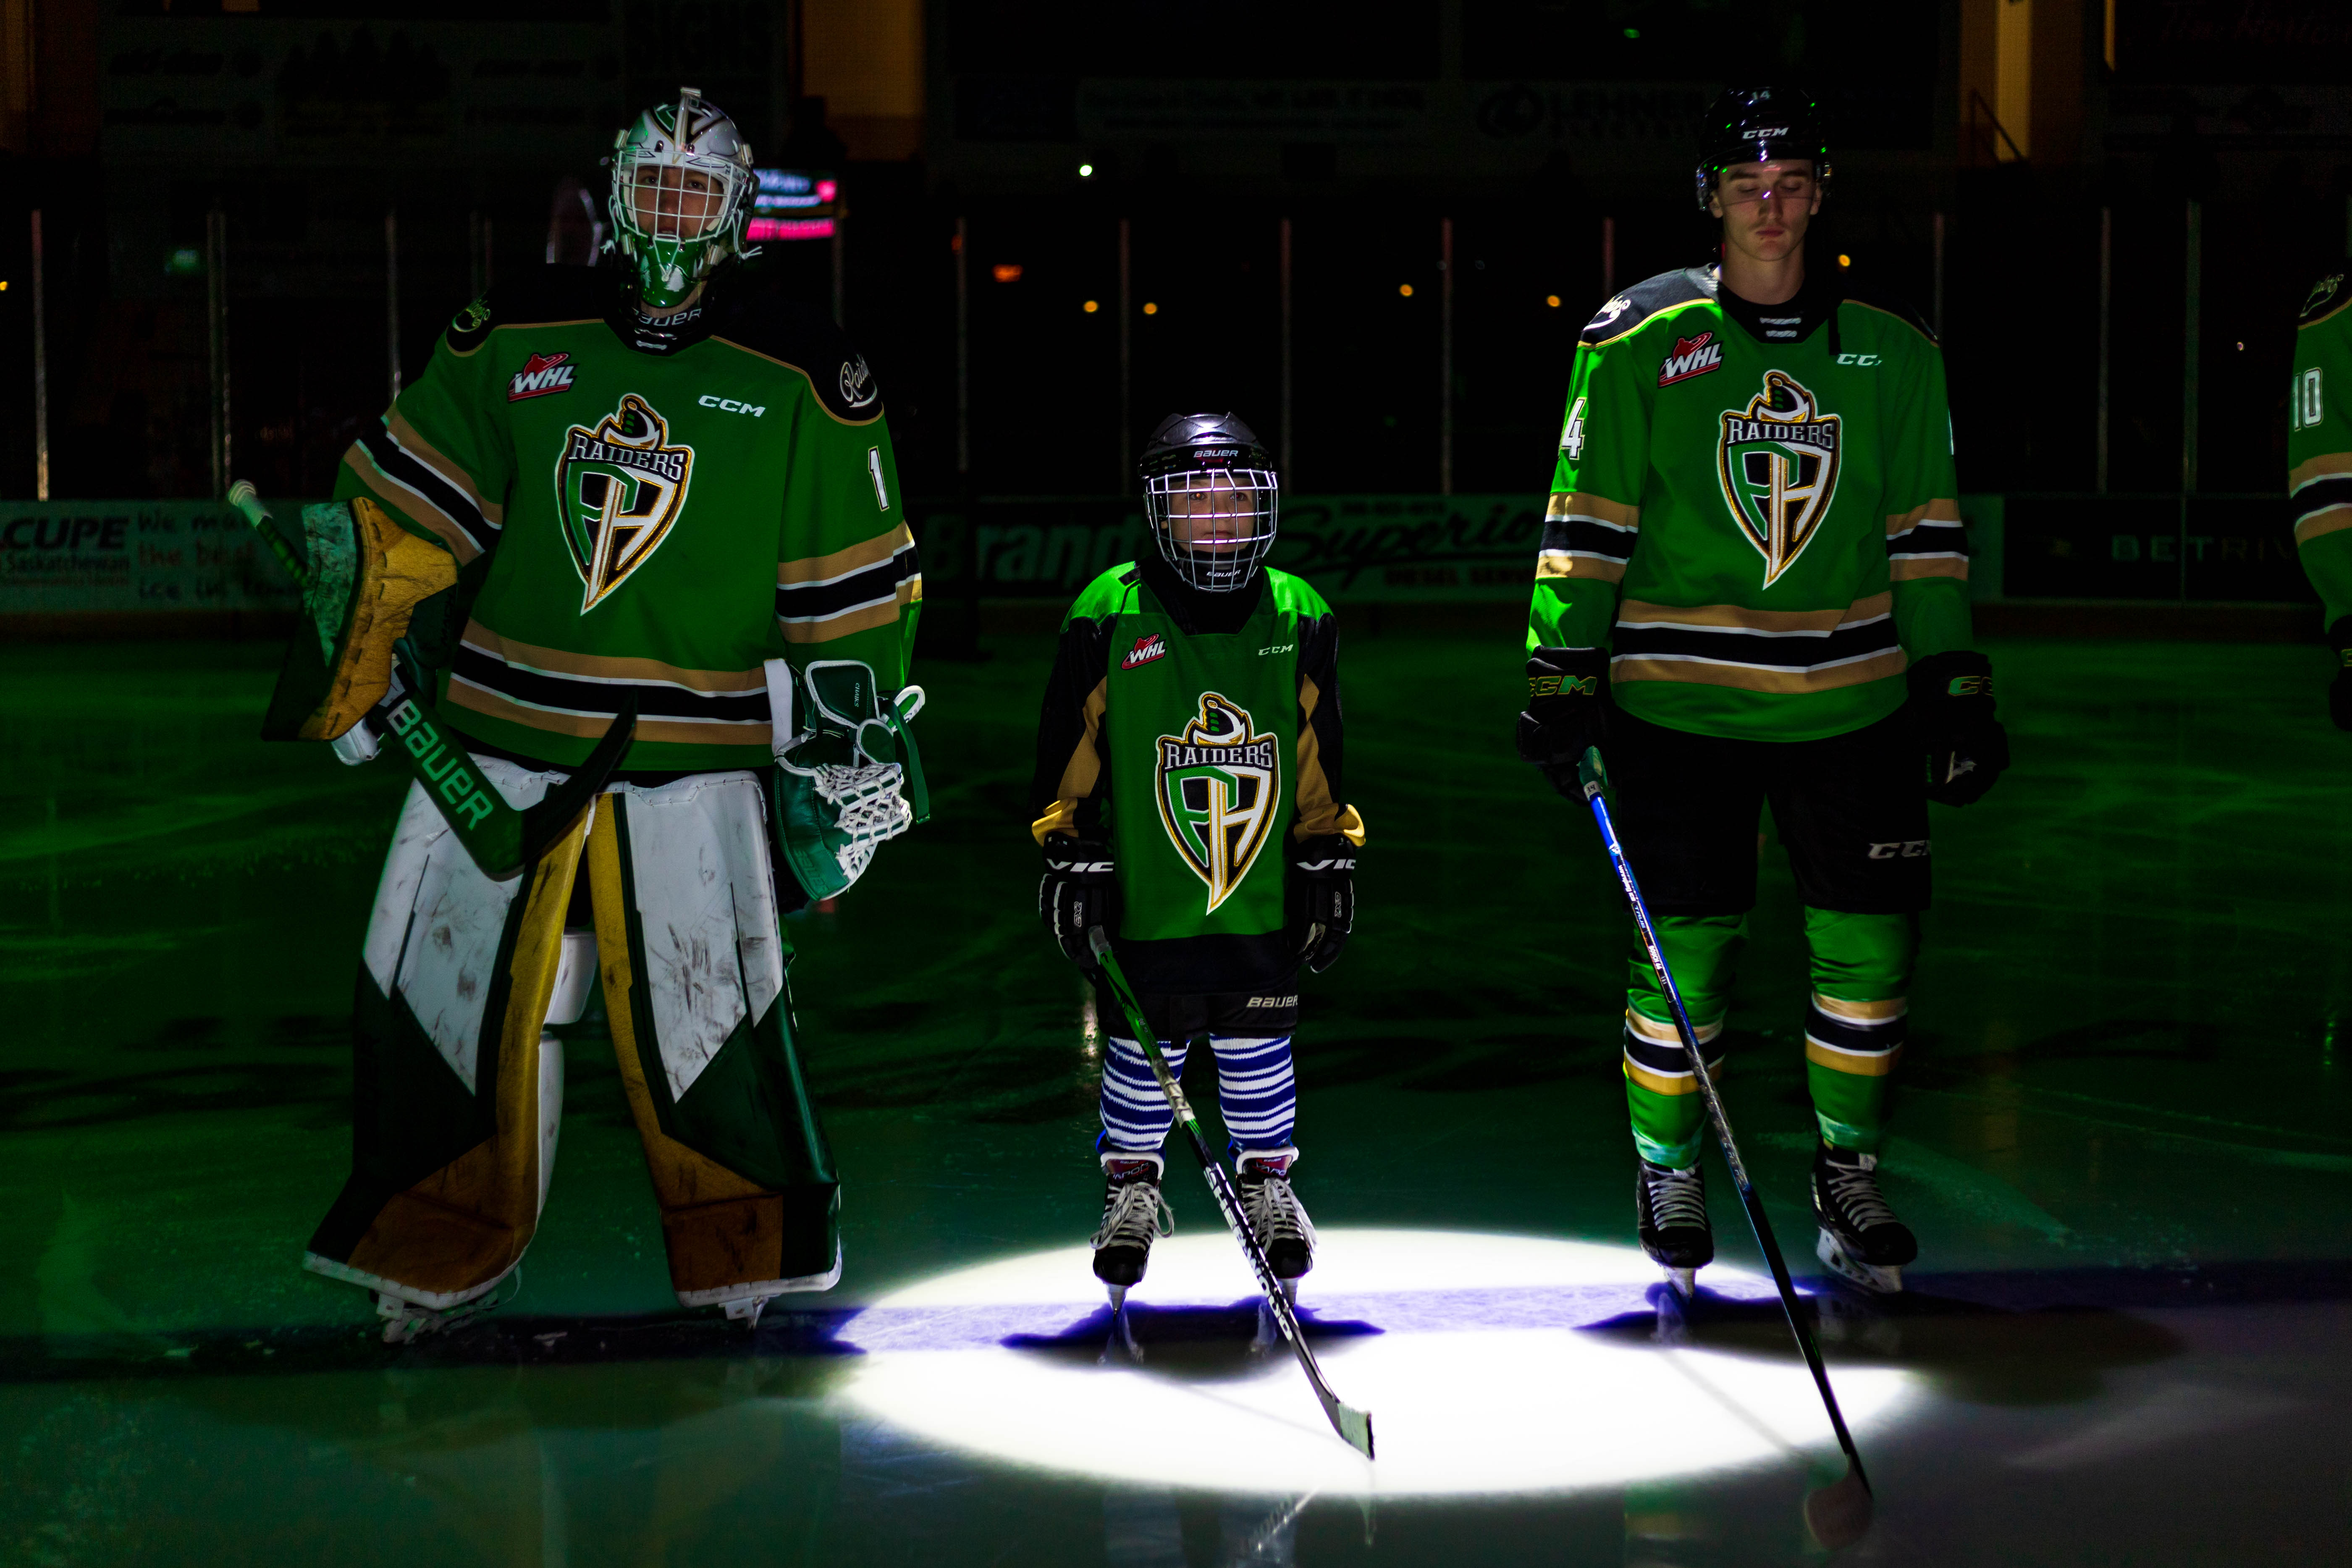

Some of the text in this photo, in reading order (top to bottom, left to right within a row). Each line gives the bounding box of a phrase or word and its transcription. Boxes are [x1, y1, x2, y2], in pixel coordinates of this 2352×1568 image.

[1741, 127, 1790, 141] CCM
[632, 308, 702, 326] AUER
[1665, 342, 1723, 379] WHL
[1836, 354, 1882, 366] CC
[512, 364, 575, 393] WHL
[698, 395, 766, 418] CCM
[1558, 396, 1587, 460] 4
[1728, 418, 1835, 449] RAIDERS
[569, 432, 684, 482] RAIDERS
[1193, 449, 1240, 458] BAUER
[1, 517, 130, 551] CUPE
[921, 513, 1154, 590] Brand
[1275, 504, 1541, 591] Superio
[2110, 533, 2295, 563] BETRIV
[1206, 569, 1242, 578] BAUER
[1129, 642, 1167, 664] WHL
[1258, 643, 1294, 656] CCM
[386, 698, 494, 831] BAUER
[1164, 741, 1273, 769] RAIDERS
[1045, 858, 1114, 873] VIC
[1296, 859, 1357, 871] VIC
[1246, 994, 1298, 1007] BAUER
[1255, 1162, 1287, 1176] VAPO
